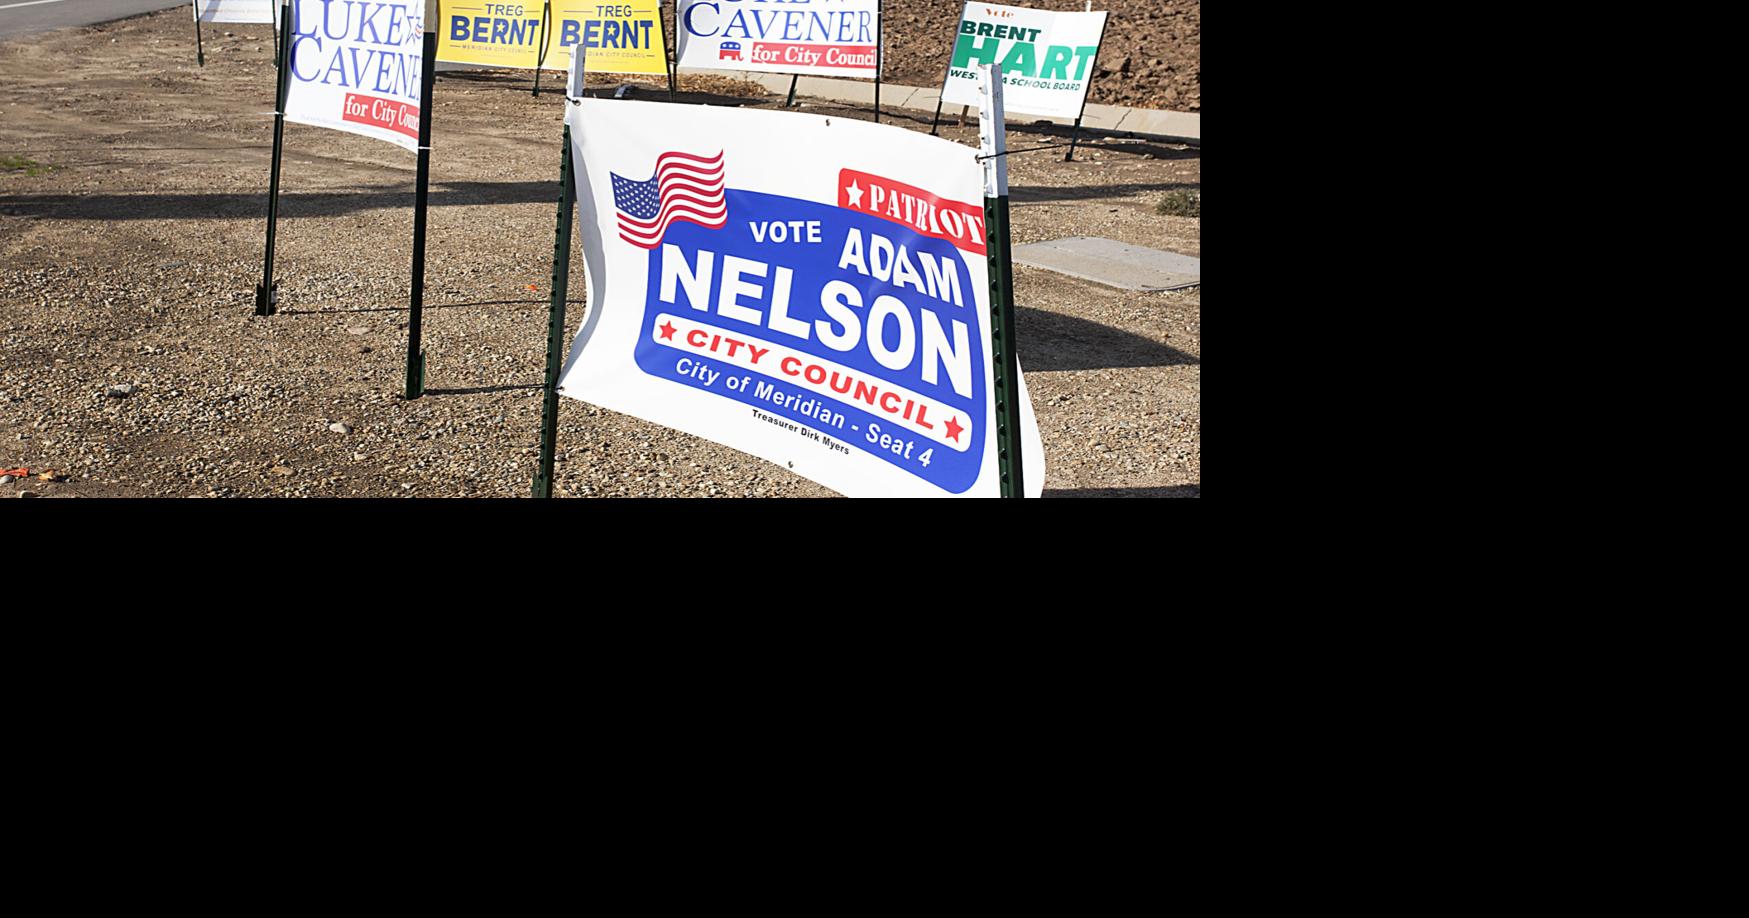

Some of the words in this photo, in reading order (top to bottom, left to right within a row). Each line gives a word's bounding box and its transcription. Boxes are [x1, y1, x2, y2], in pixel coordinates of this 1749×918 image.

[291, 0, 406, 46] LUKE
[485, 4, 523, 16] TREG
[595, 5, 632, 17] TREG
[684, 2, 872, 42] CAVENER
[450, 15, 539, 46] BERNT
[560, 19, 654, 49] BERNT
[960, 20, 1041, 42] BRENT
[289, 35, 420, 101] CAVENE
[752, 44, 781, 63] for
[784, 46, 821, 66] City
[952, 34, 1098, 80] HART
[950, 69, 978, 80] WES
[1010, 77, 1051, 89] SCHOOL
[1054, 82, 1081, 91] BOARD
[345, 95, 368, 117] for
[371, 99, 397, 127] City
[749, 220, 822, 243] VOTE
[869, 183, 985, 246] PATRIOT
[838, 227, 964, 308] ADAM
[659, 243, 973, 399] NELSON
[686, 329, 770, 364] CITY
[780, 356, 934, 430] COUNCIL
[675, 358, 720, 386] City
[726, 376, 750, 393] of
[754, 381, 846, 429] Meridian
[865, 423, 914, 459] Seat
[918, 447, 935, 468] 4
[752, 409, 798, 432] Treasurer
[801, 427, 820, 442] Dirk
[822, 436, 850, 455] Myers
